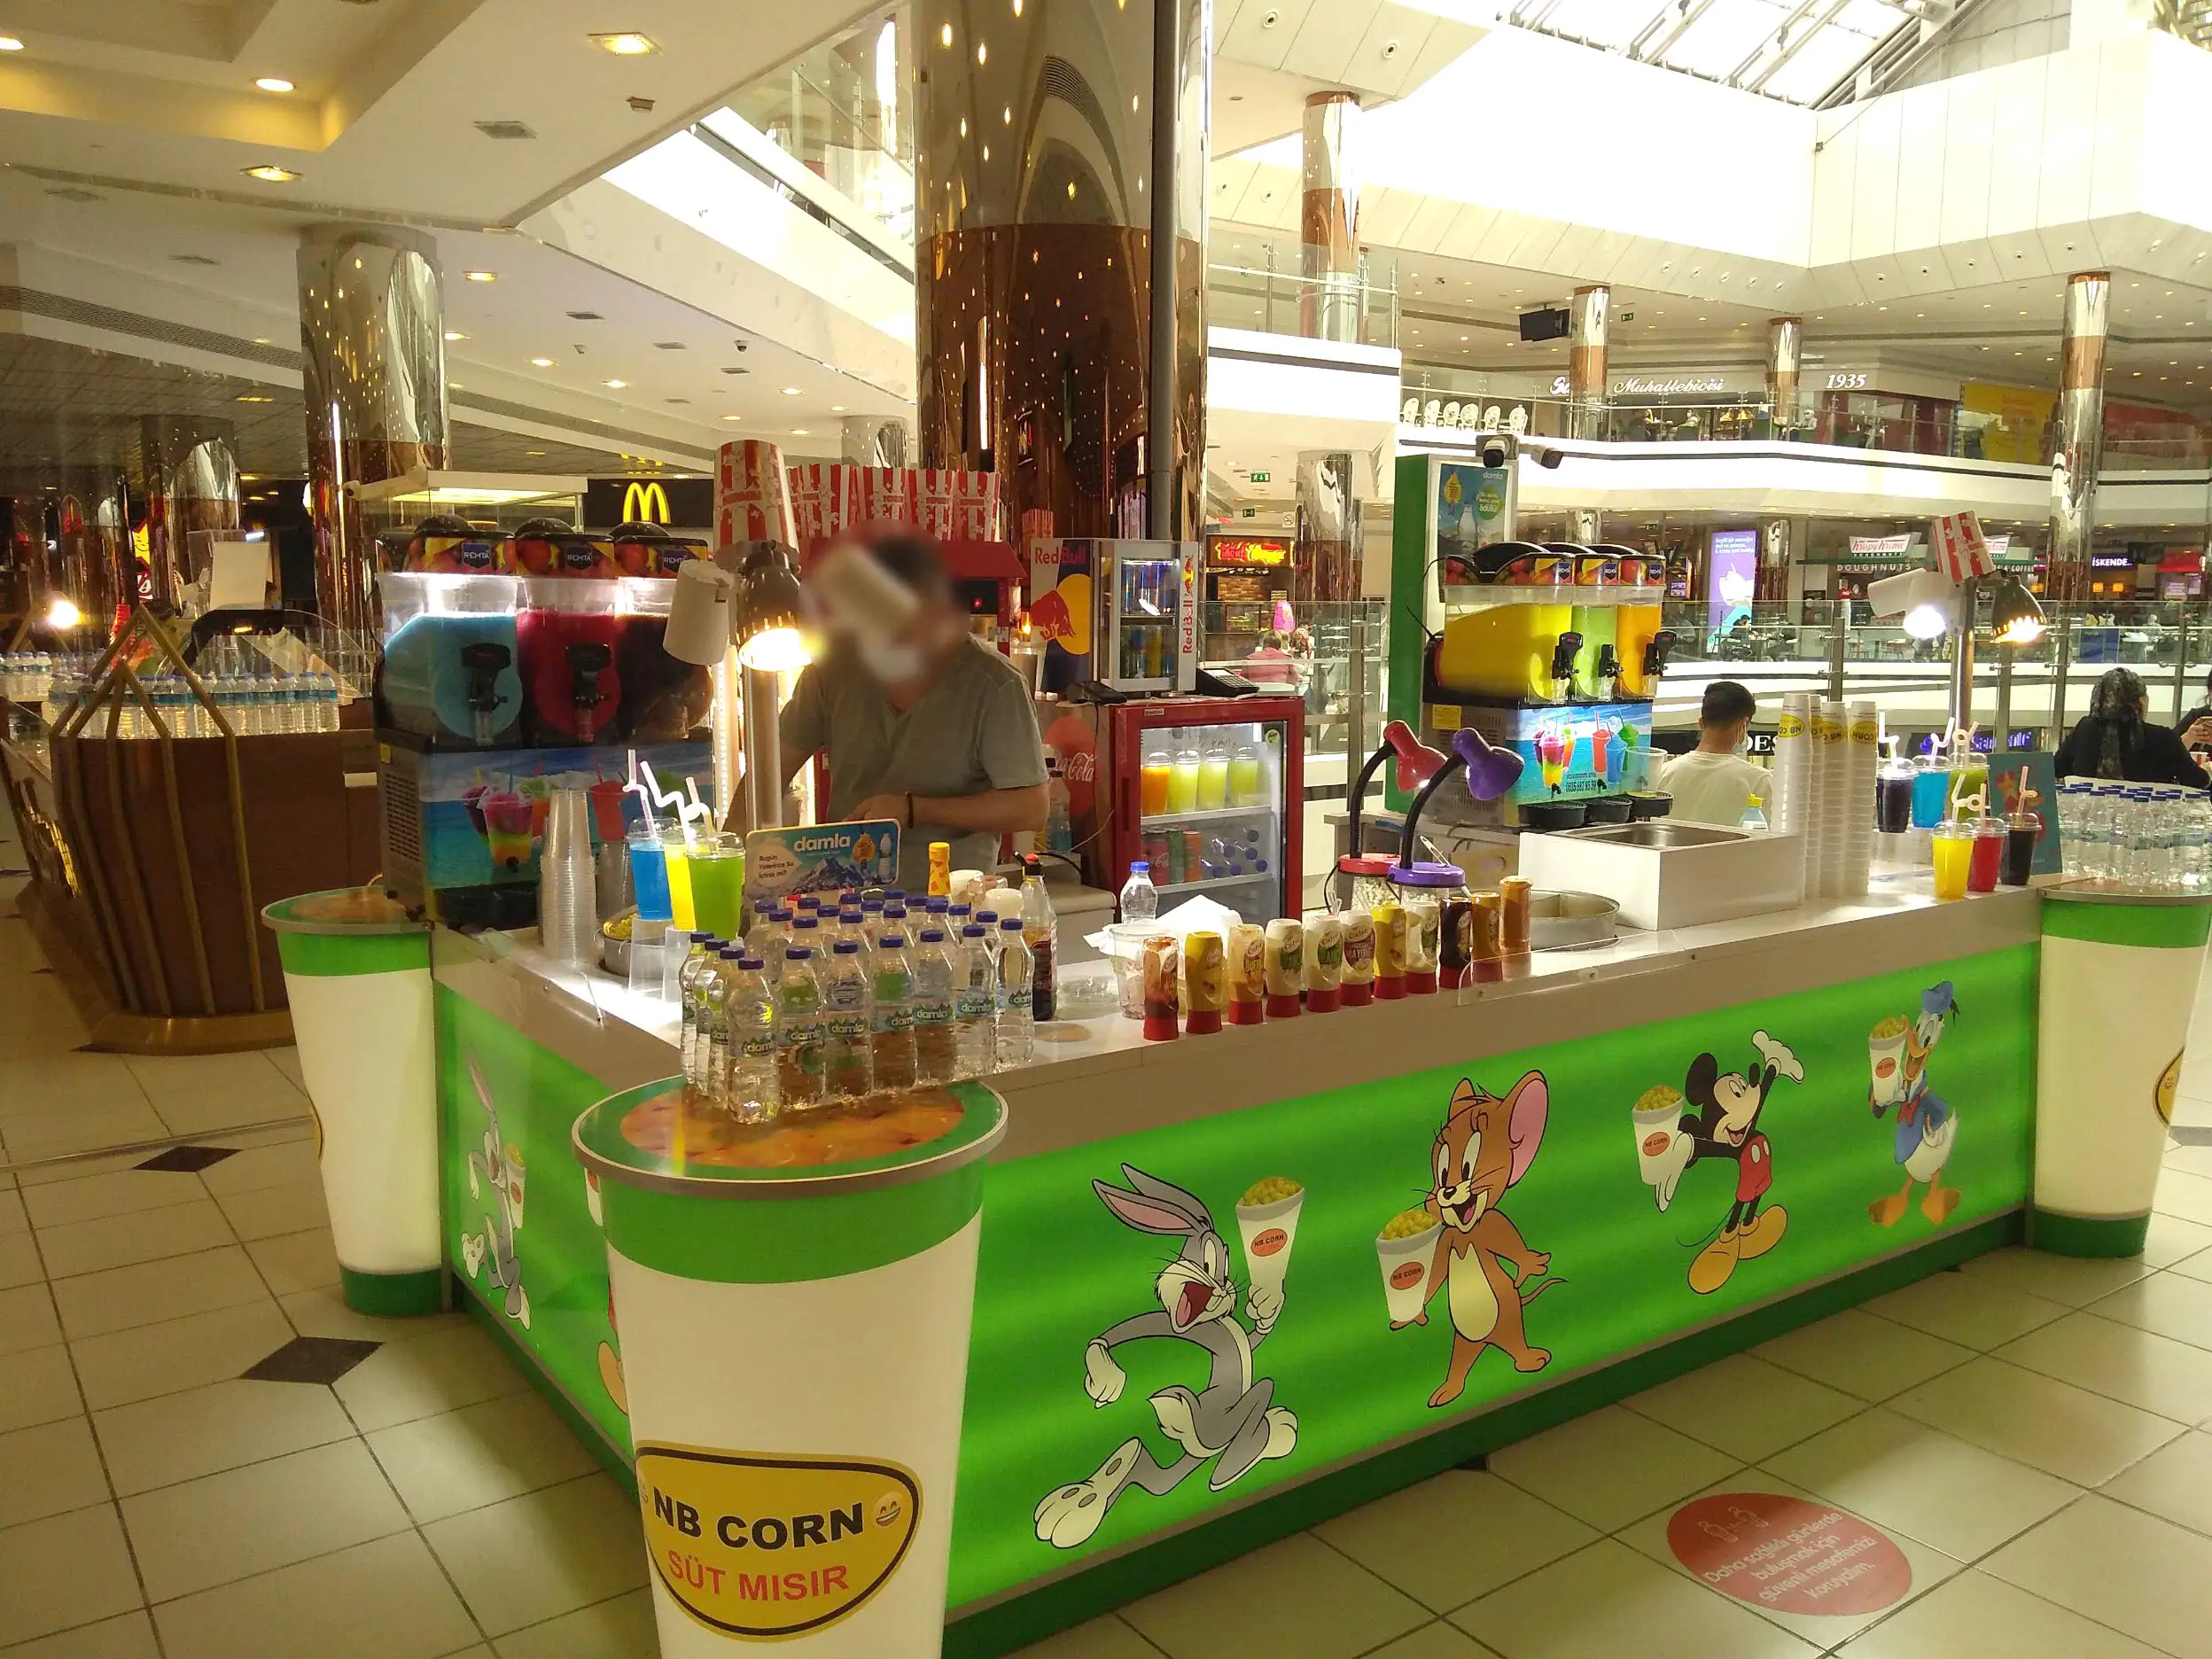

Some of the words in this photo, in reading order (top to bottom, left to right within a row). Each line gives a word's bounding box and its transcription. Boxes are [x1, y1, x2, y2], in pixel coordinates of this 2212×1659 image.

[1613, 377, 1725, 393] Muhallebicisi
[1826, 373, 1866, 389] 1935
[1483, 471, 1504, 479] damla
[623, 482, 671, 525] M
[463, 550, 490, 559] REMTA
[567, 553, 593, 562] REMTA
[1034, 547, 1059, 565] Red
[1061, 547, 1087, 564] Bull
[1836, 563, 1912, 572] DOUGHNUTS
[2091, 557, 2132, 567] İSKENDE
[1182, 600, 1193, 625] Bull
[1182, 626, 1193, 654] Red
[794, 833, 851, 852] damla
[1014, 993, 1032, 1004] dam
[916, 1008, 946, 1019] damla
[961, 1001, 991, 1013] damla
[831, 1022, 864, 1033] damla
[891, 1016, 914, 1026] dam
[791, 1028, 822, 1040] damla
[1266, 1234, 1284, 1244] CORN
[1404, 1267, 1421, 1277] CORN
[652, 1484, 703, 1538] NB
[716, 1501, 864, 1550] CORN
[1702, 1559, 1746, 1583] Daha
[1742, 1537, 1788, 1566] sağlıklı
[1787, 1512, 1843, 1545] günlerde
[1751, 1545, 1817, 1580] buluşmak
[1815, 1534, 1841, 1553] için
[667, 1549, 726, 1595] SÜT
[738, 1564, 849, 1601] MISIR
[1758, 1571, 1806, 1602] güvenli
[1805, 1535, 1878, 1576] mesafemizi
[1803, 1562, 1876, 1600] koruyalım.
